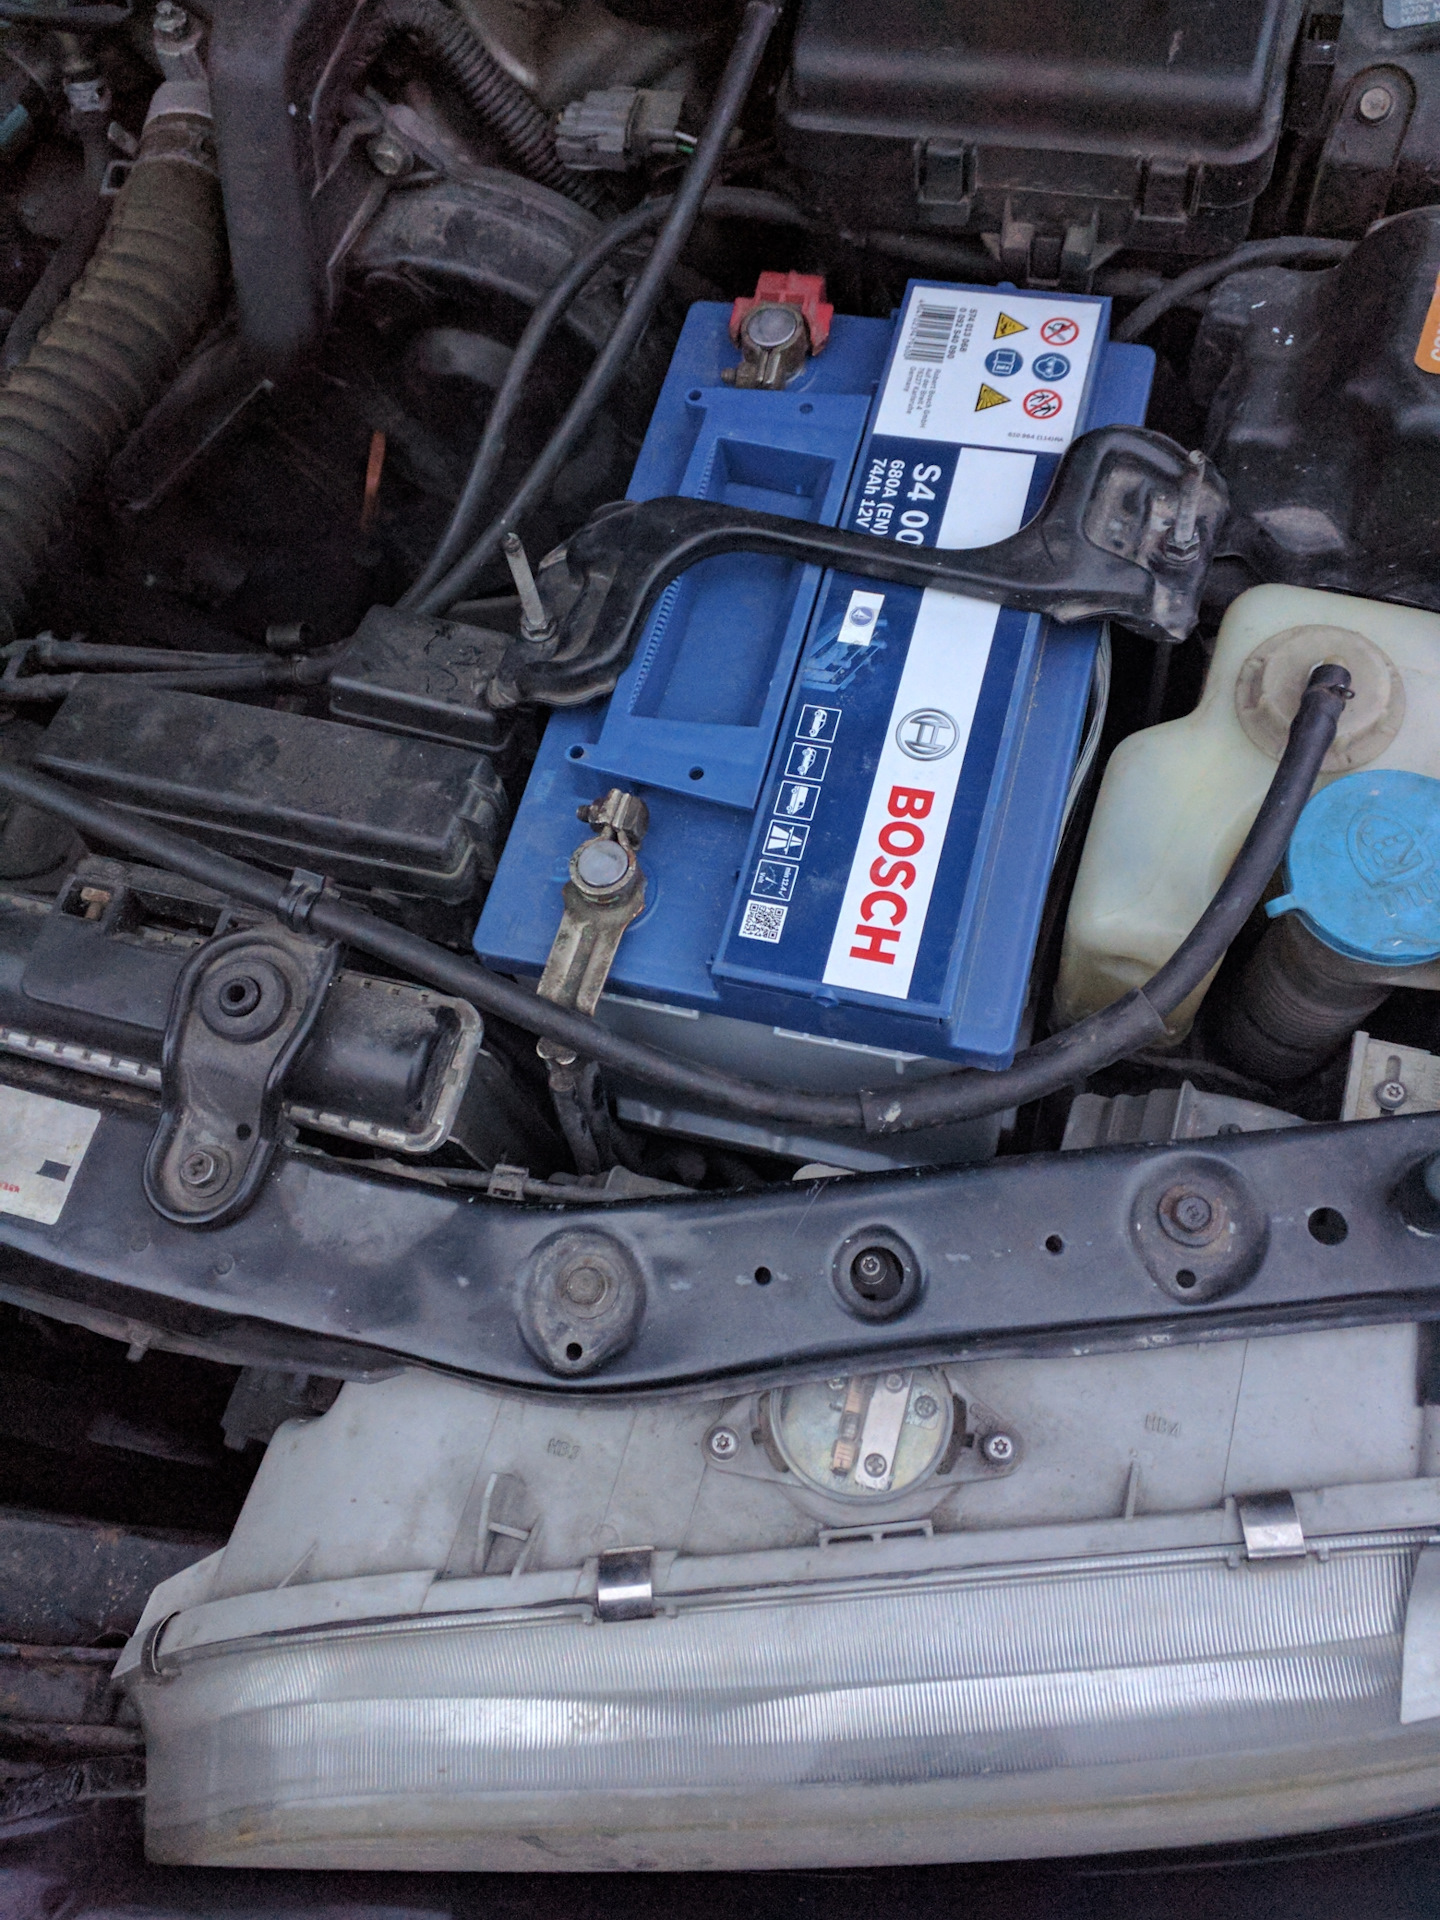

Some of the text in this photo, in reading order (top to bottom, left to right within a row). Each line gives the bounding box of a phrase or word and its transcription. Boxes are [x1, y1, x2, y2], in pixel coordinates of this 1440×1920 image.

[920, 368, 941, 428] Robert Bosch GmbH
[855, 458, 888, 528] 74Ah 12V
[869, 459, 906, 536] 680A (EN)
[907, 463, 942, 501] S4
[757, 872, 766, 884] Volt
[783, 867, 791, 878] min
[849, 785, 935, 965] BOSCH
